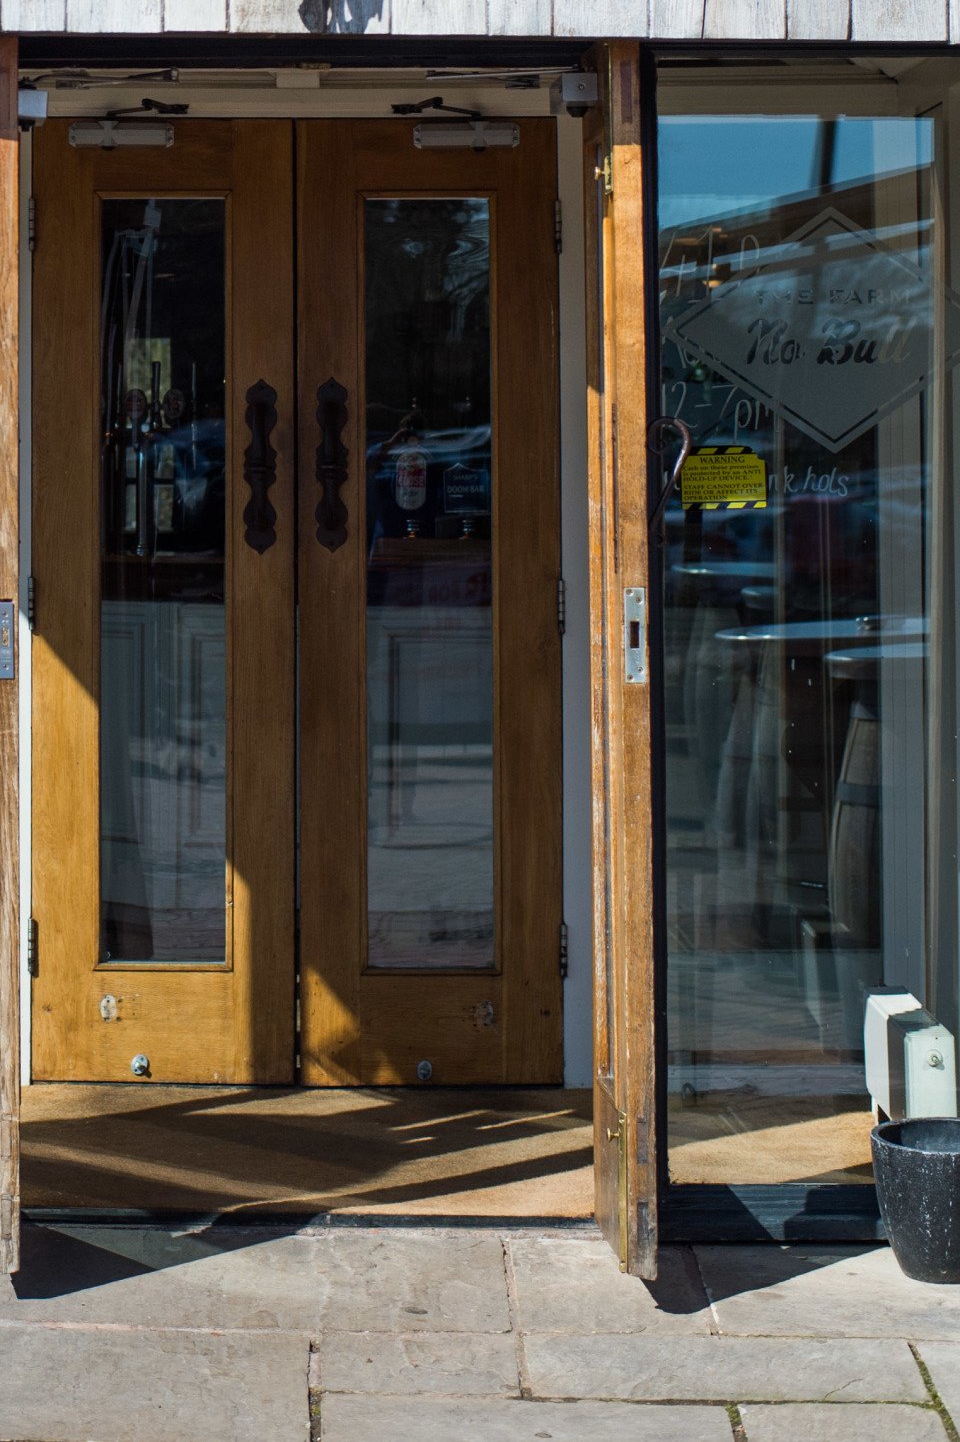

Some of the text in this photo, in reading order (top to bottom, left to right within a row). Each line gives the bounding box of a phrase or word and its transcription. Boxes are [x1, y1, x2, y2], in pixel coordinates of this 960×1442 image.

[746, 318, 805, 365] No
[817, 316, 912, 365] Bull
[700, 455, 745, 464] WARNING
[803, 465, 850, 497] hols
